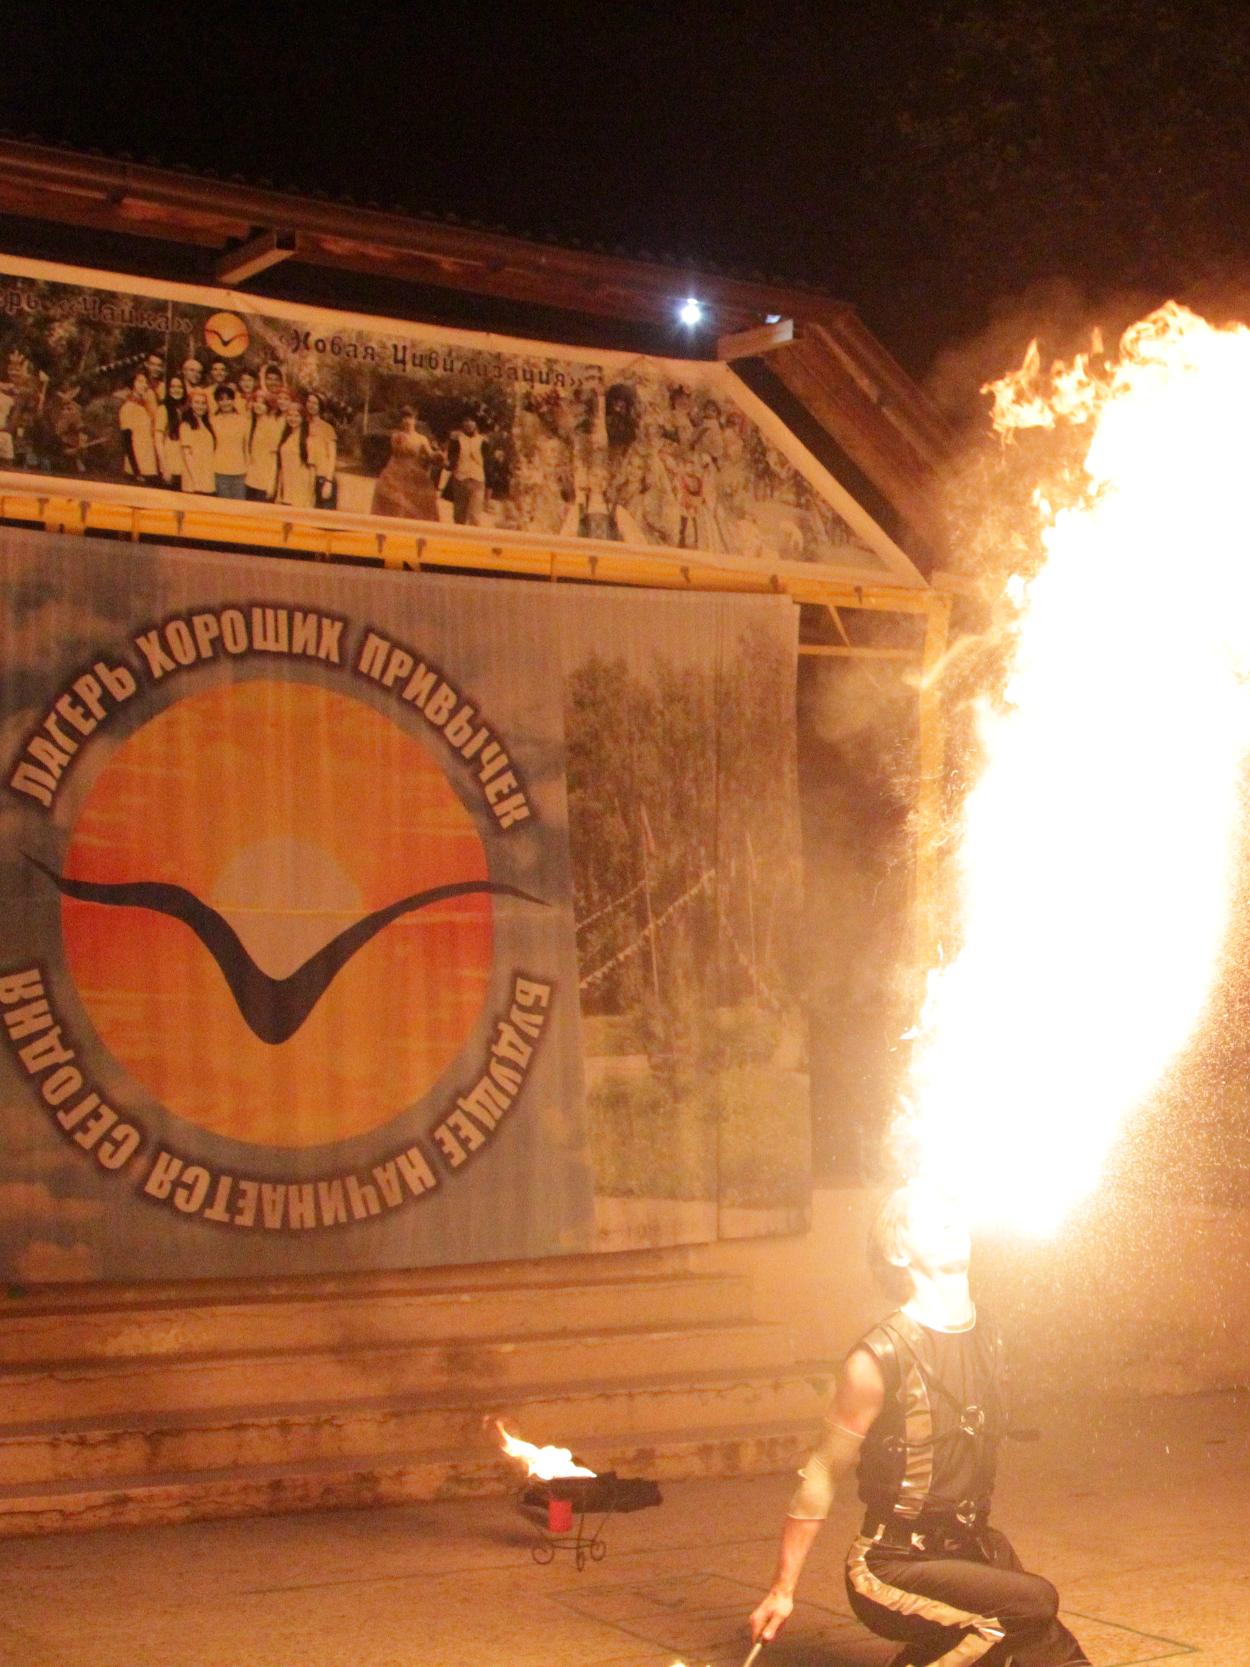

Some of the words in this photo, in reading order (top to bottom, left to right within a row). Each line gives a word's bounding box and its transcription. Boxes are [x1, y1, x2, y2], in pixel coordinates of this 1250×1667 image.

[10, 661, 137, 807] ЛАГЕРЬ
[135, 606, 345, 678] ХОРОШИХ
[359, 632, 531, 830] ПРИВЫЧЕК
[0, 968, 142, 1170] СЕГОДНЯ
[435, 976, 551, 1168] БУДУЩЕЕ
[144, 1147, 437, 1230] НАЧИНАЕТСЯ
